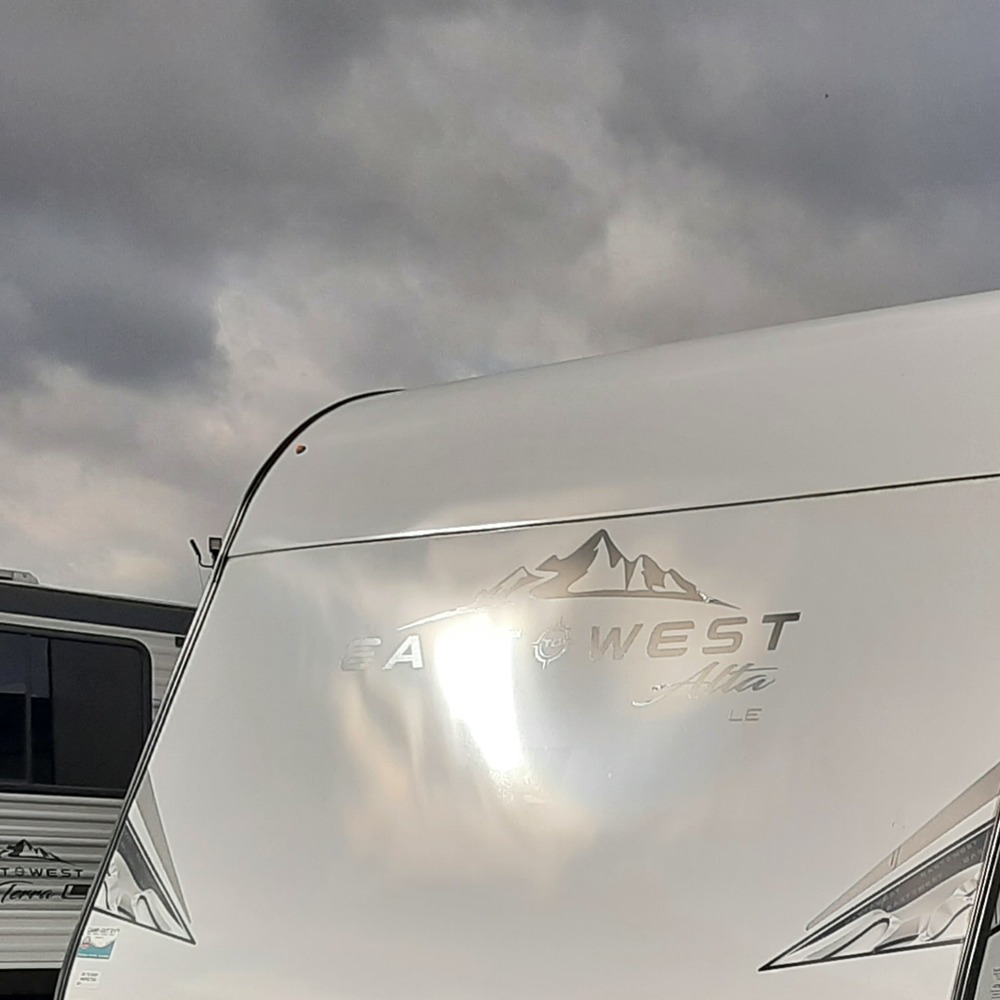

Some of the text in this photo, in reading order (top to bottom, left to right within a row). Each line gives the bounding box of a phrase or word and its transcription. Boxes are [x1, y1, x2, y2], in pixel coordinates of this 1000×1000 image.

[588, 611, 801, 661] WEST
[631, 660, 779, 707] Alta
[727, 707, 763, 722] LE
